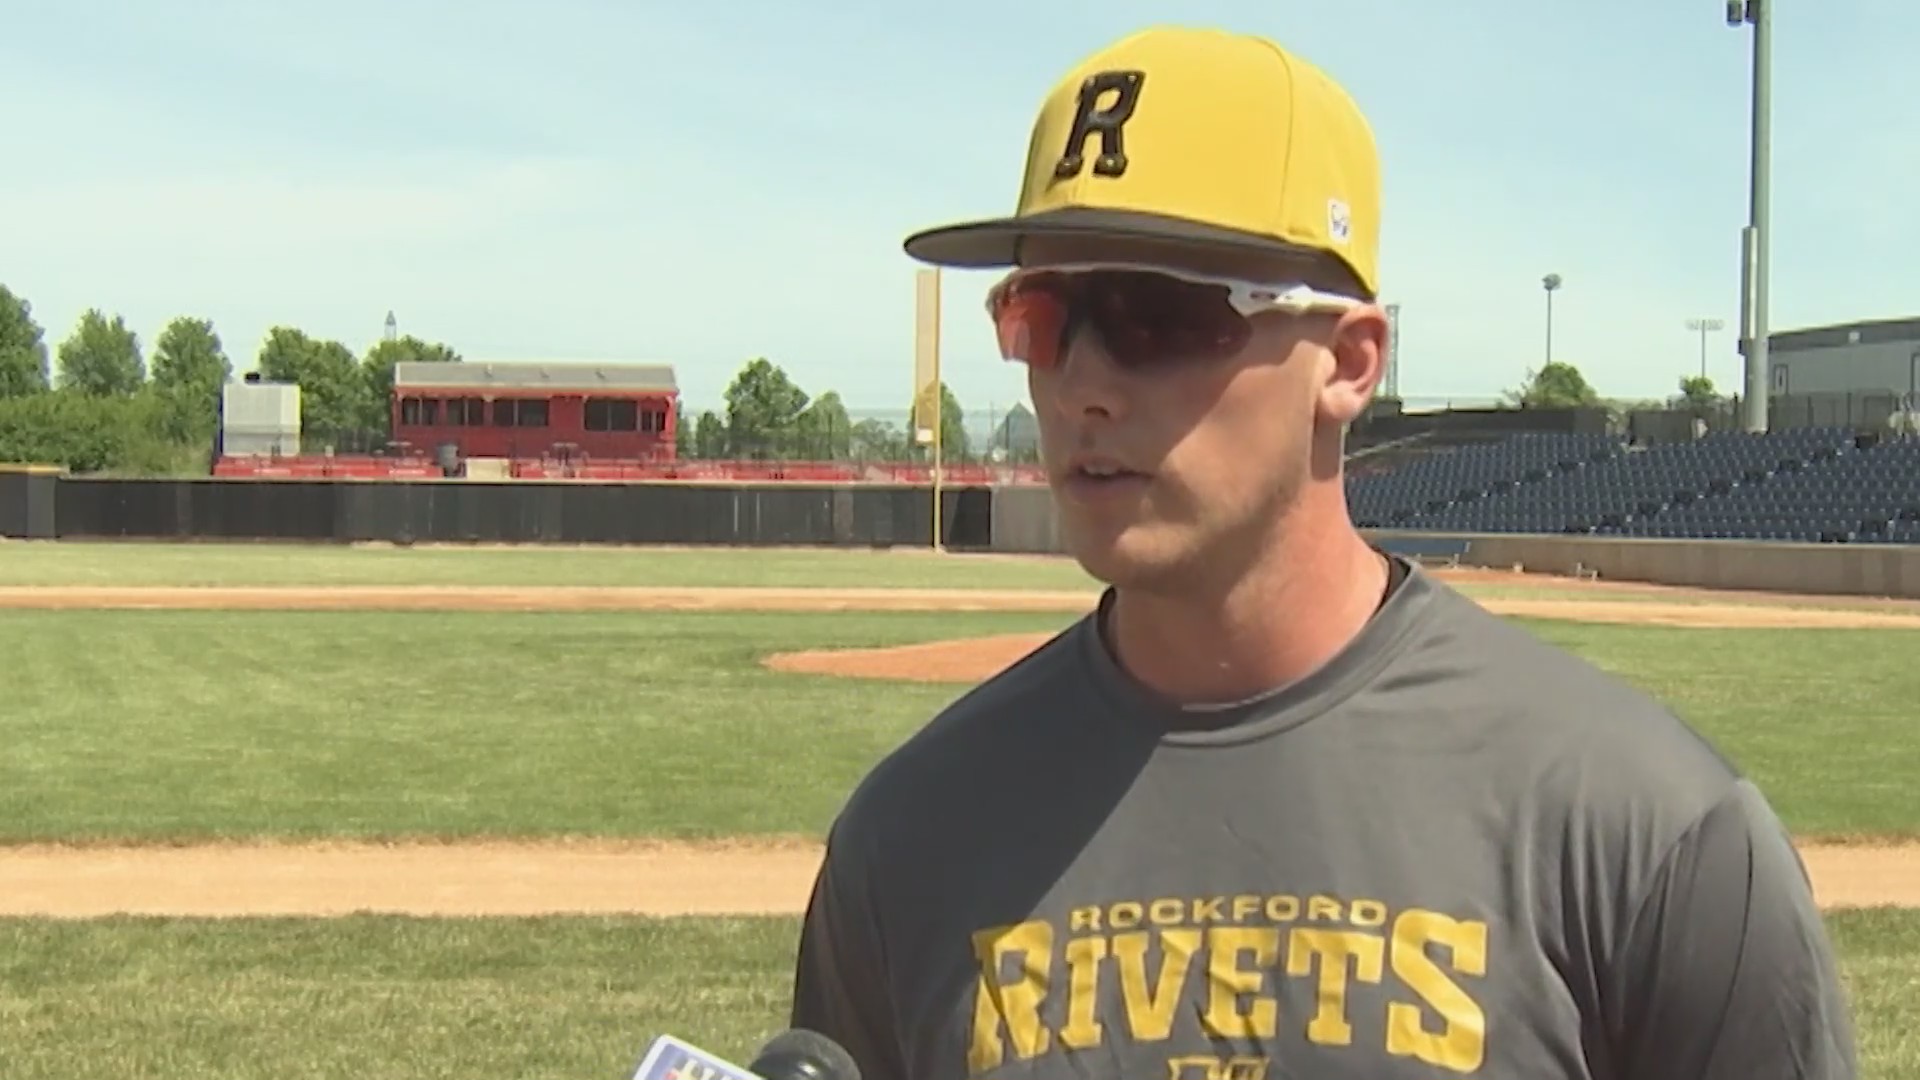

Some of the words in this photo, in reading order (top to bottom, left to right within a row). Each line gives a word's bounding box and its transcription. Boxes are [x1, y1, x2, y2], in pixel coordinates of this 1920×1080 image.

[1053, 70, 1146, 179] R
[1070, 895, 1387, 932] ROCKFORD
[967, 908, 1488, 1076] RIVETS
